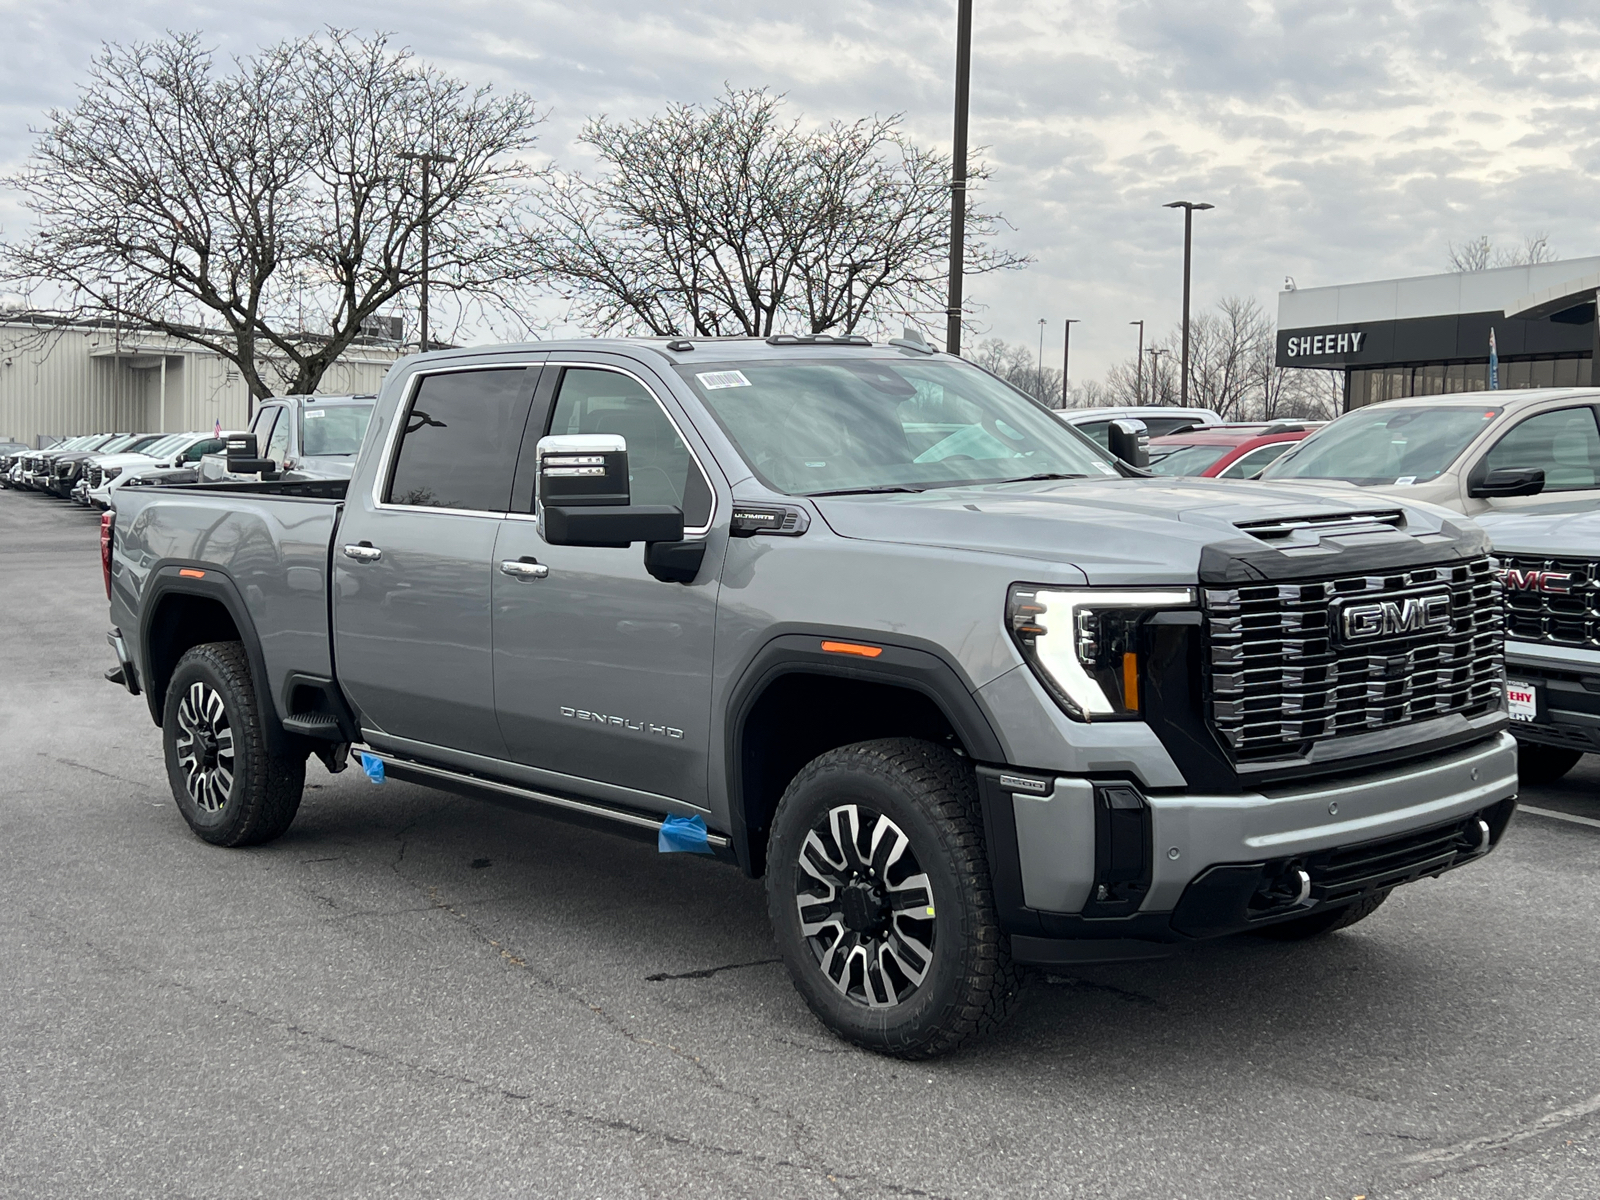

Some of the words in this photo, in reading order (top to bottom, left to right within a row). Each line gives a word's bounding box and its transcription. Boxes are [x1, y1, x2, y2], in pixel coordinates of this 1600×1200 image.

[1287, 332, 1362, 357] SHEEHY
[734, 513, 775, 521] ULTIMATE
[1343, 594, 1450, 640] GMC
[560, 706, 645, 732] DENALI
[649, 723, 685, 740] HD
